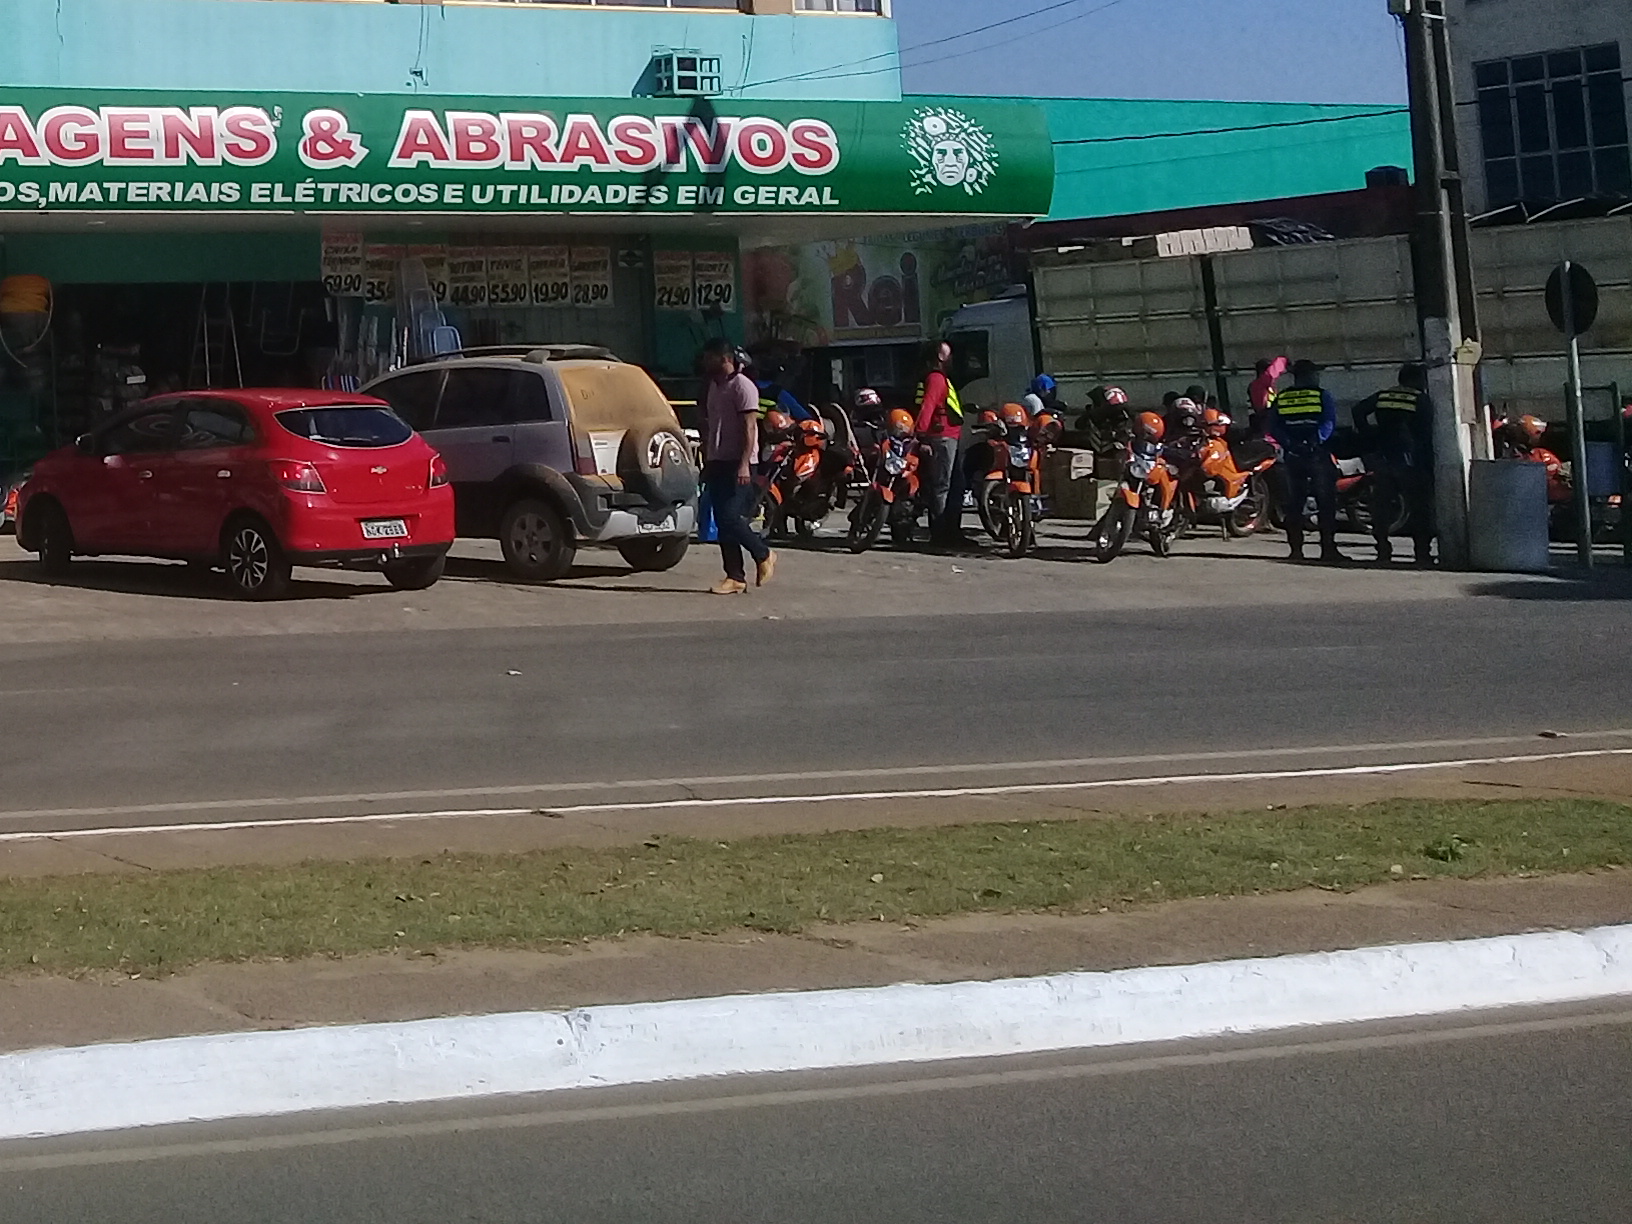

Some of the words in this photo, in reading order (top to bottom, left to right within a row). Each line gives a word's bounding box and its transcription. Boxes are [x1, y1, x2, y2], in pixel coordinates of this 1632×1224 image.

[298, 109, 369, 170] &
[387, 109, 840, 175] ABRASIVOS
[472, 184, 669, 206] UTILIDADES
[677, 185, 725, 206] EM
[733, 186, 840, 206] GERAL
[831, 252, 921, 327] Rei
